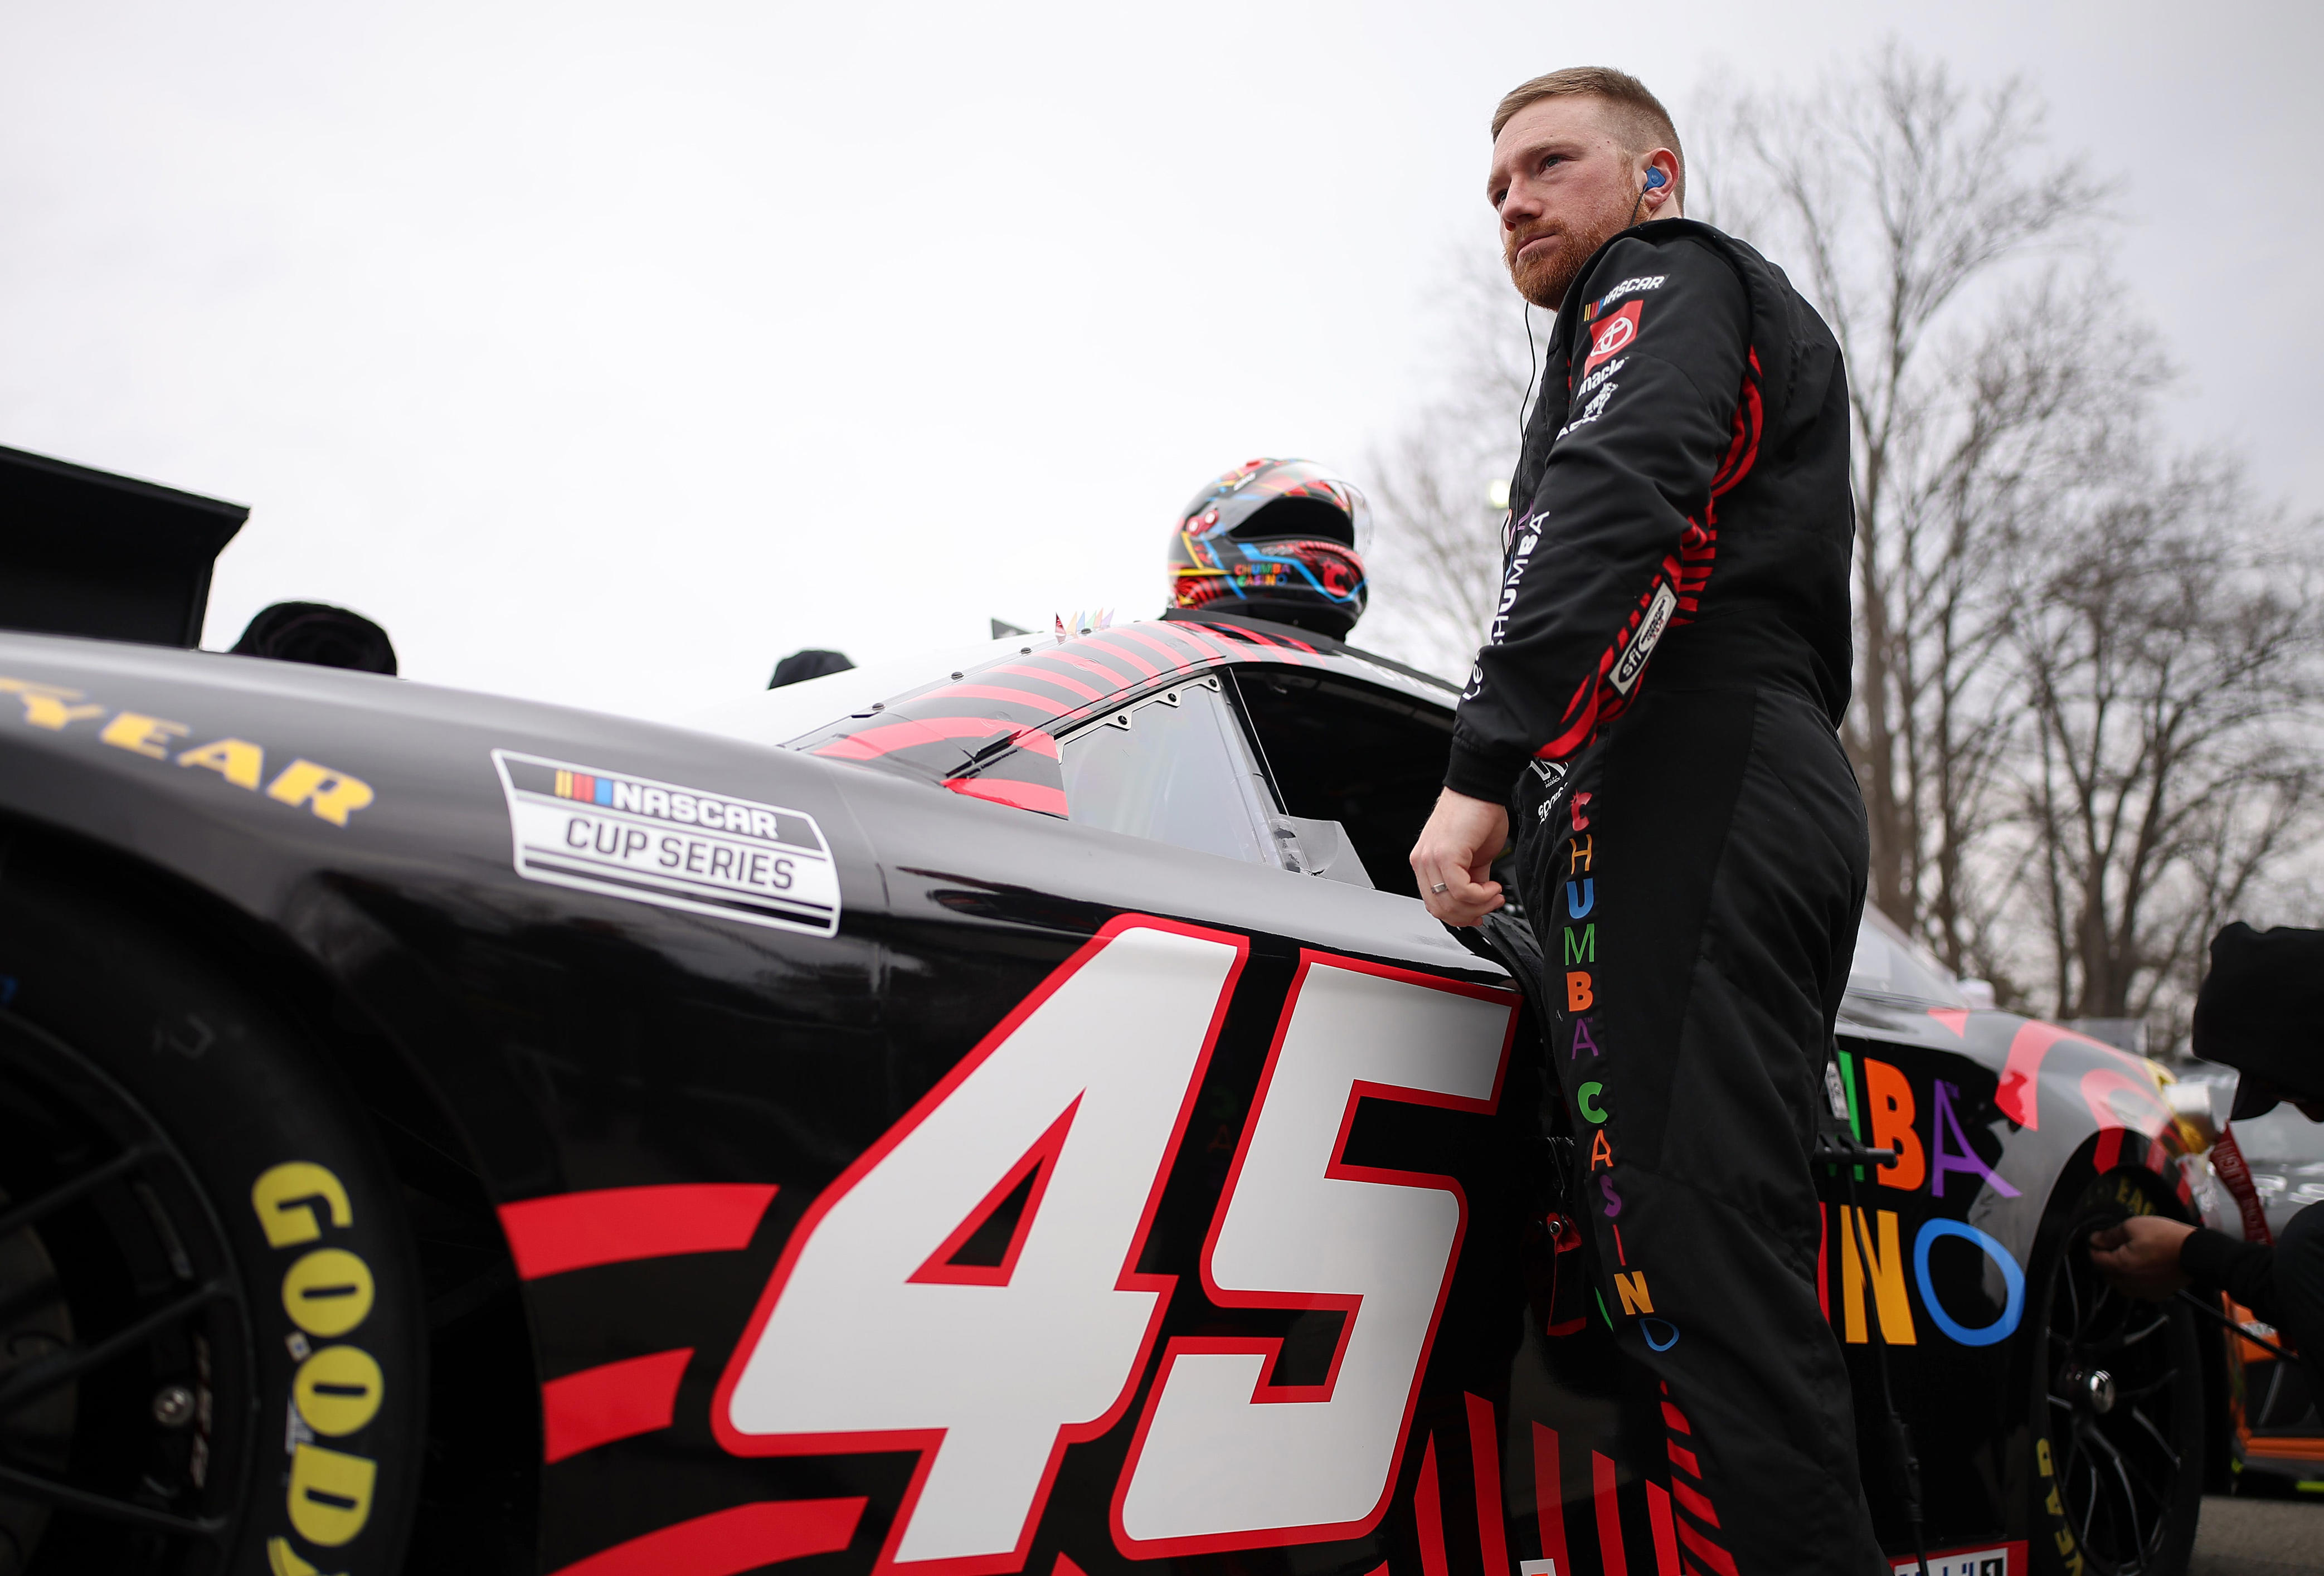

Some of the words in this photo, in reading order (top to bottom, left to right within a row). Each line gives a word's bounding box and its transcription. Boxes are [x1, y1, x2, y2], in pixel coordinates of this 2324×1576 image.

[1603, 276, 1665, 307] NASCAR
[1576, 358, 1625, 400] nacle
[1234, 563, 1291, 576] CHUMBA
[1236, 574, 1288, 587] CASINO
[1490, 510, 1550, 646] HUMBA
[1622, 648, 1642, 677] sfi
[614, 781, 779, 840] NASCAR
[566, 818, 648, 859] CUP
[659, 838, 795, 890] SERIES
[1563, 788, 1599, 1061] CHUMBA
[710, 912, 1524, 1576] 45
[1577, 1081, 1680, 1351] CASINO
